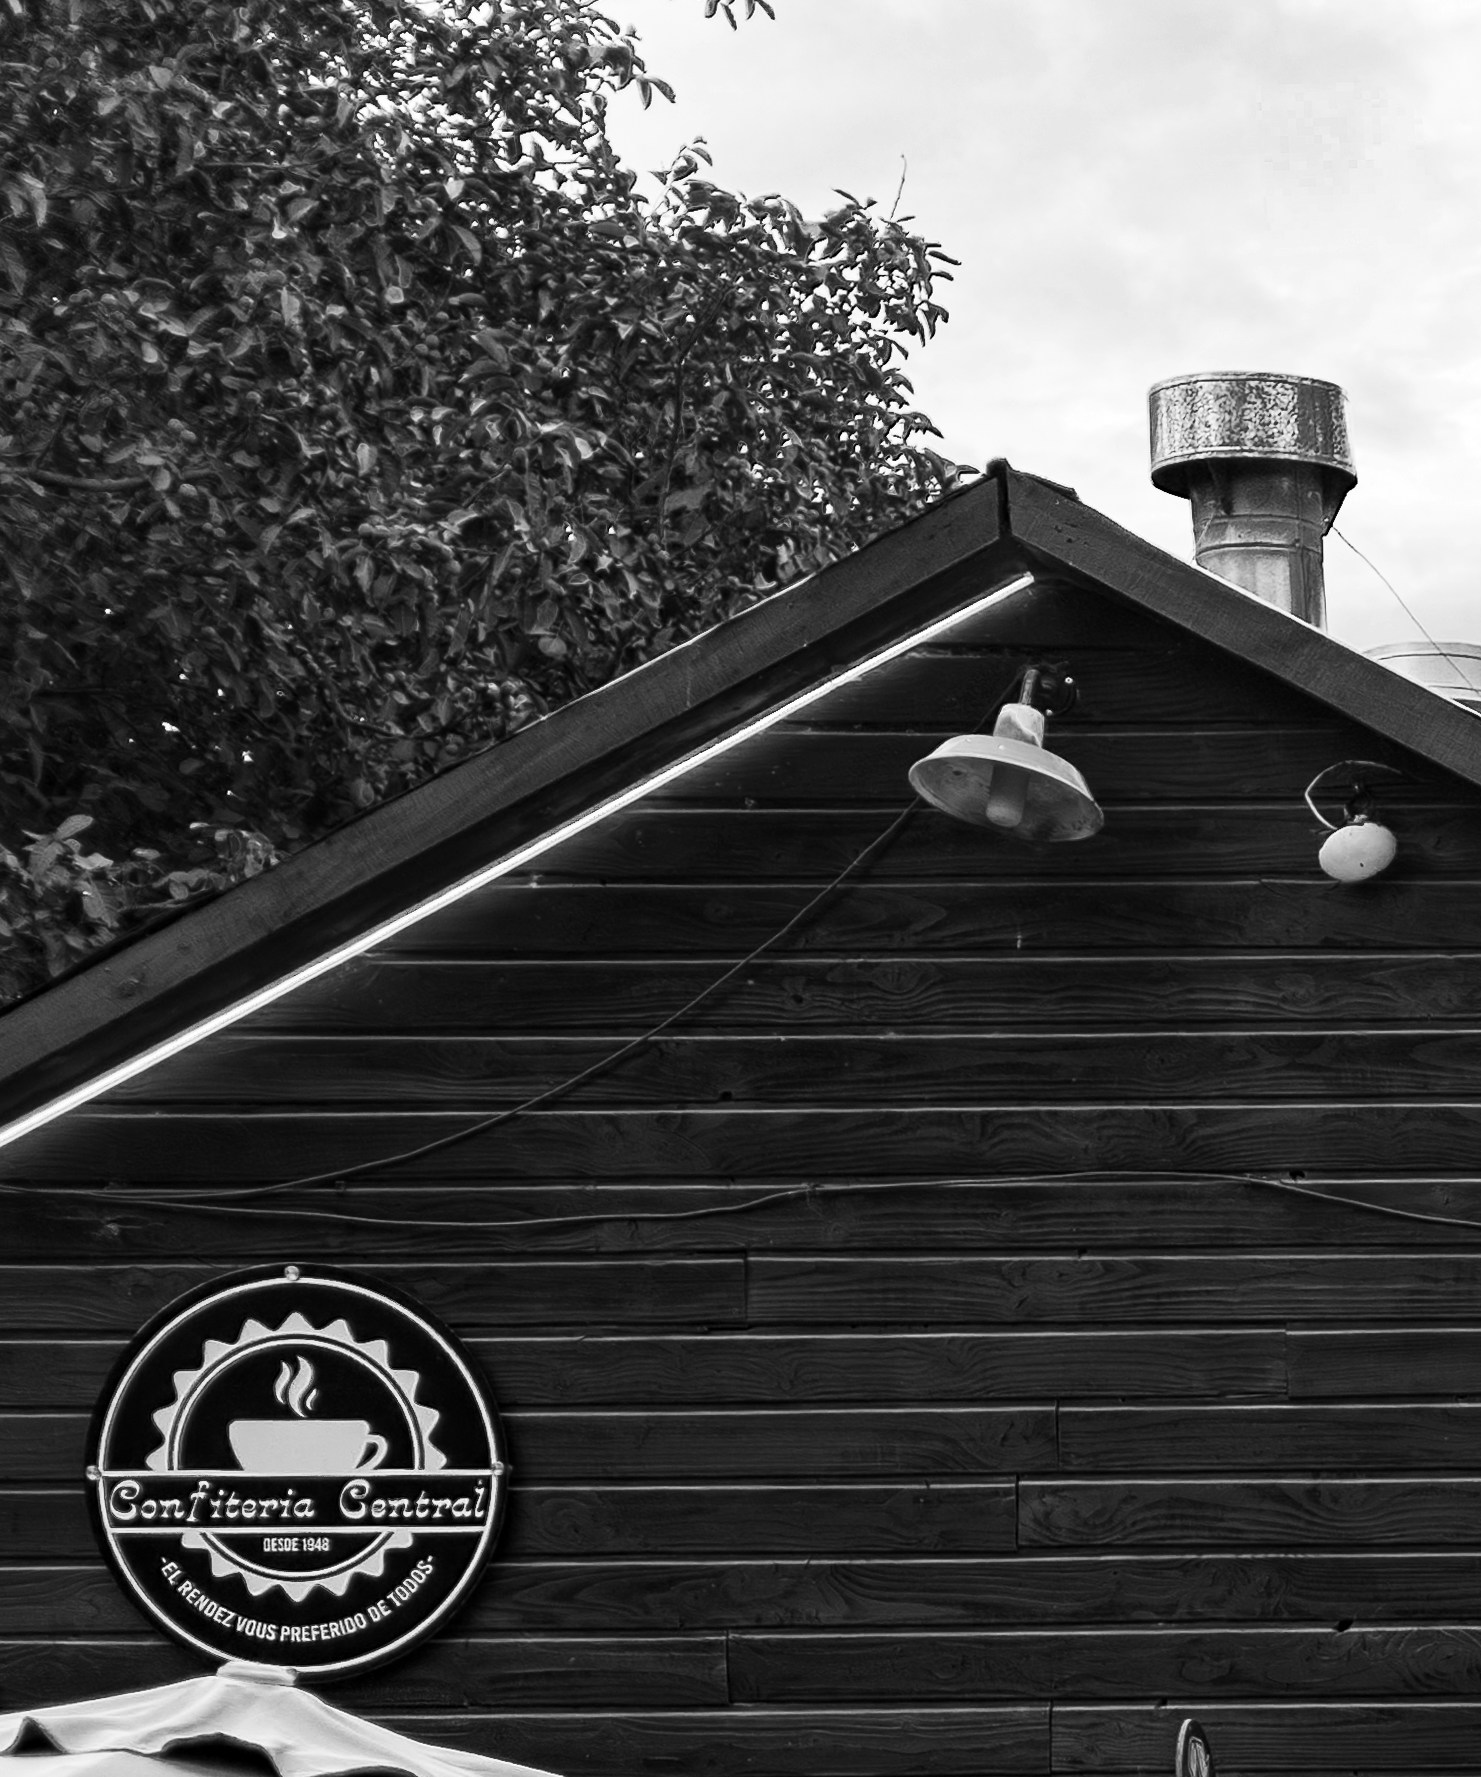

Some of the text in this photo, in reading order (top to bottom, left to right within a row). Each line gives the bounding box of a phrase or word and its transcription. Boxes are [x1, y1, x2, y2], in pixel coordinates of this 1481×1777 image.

[109, 1478, 486, 1523] Confiteria Central
[263, 1537, 331, 1552] DESDE 1948
[177, 1579, 236, 1628] RENDEZ
[236, 1616, 277, 1642] VOUS
[279, 1612, 367, 1643] PREFERIDO
[367, 1599, 392, 1623] DE
